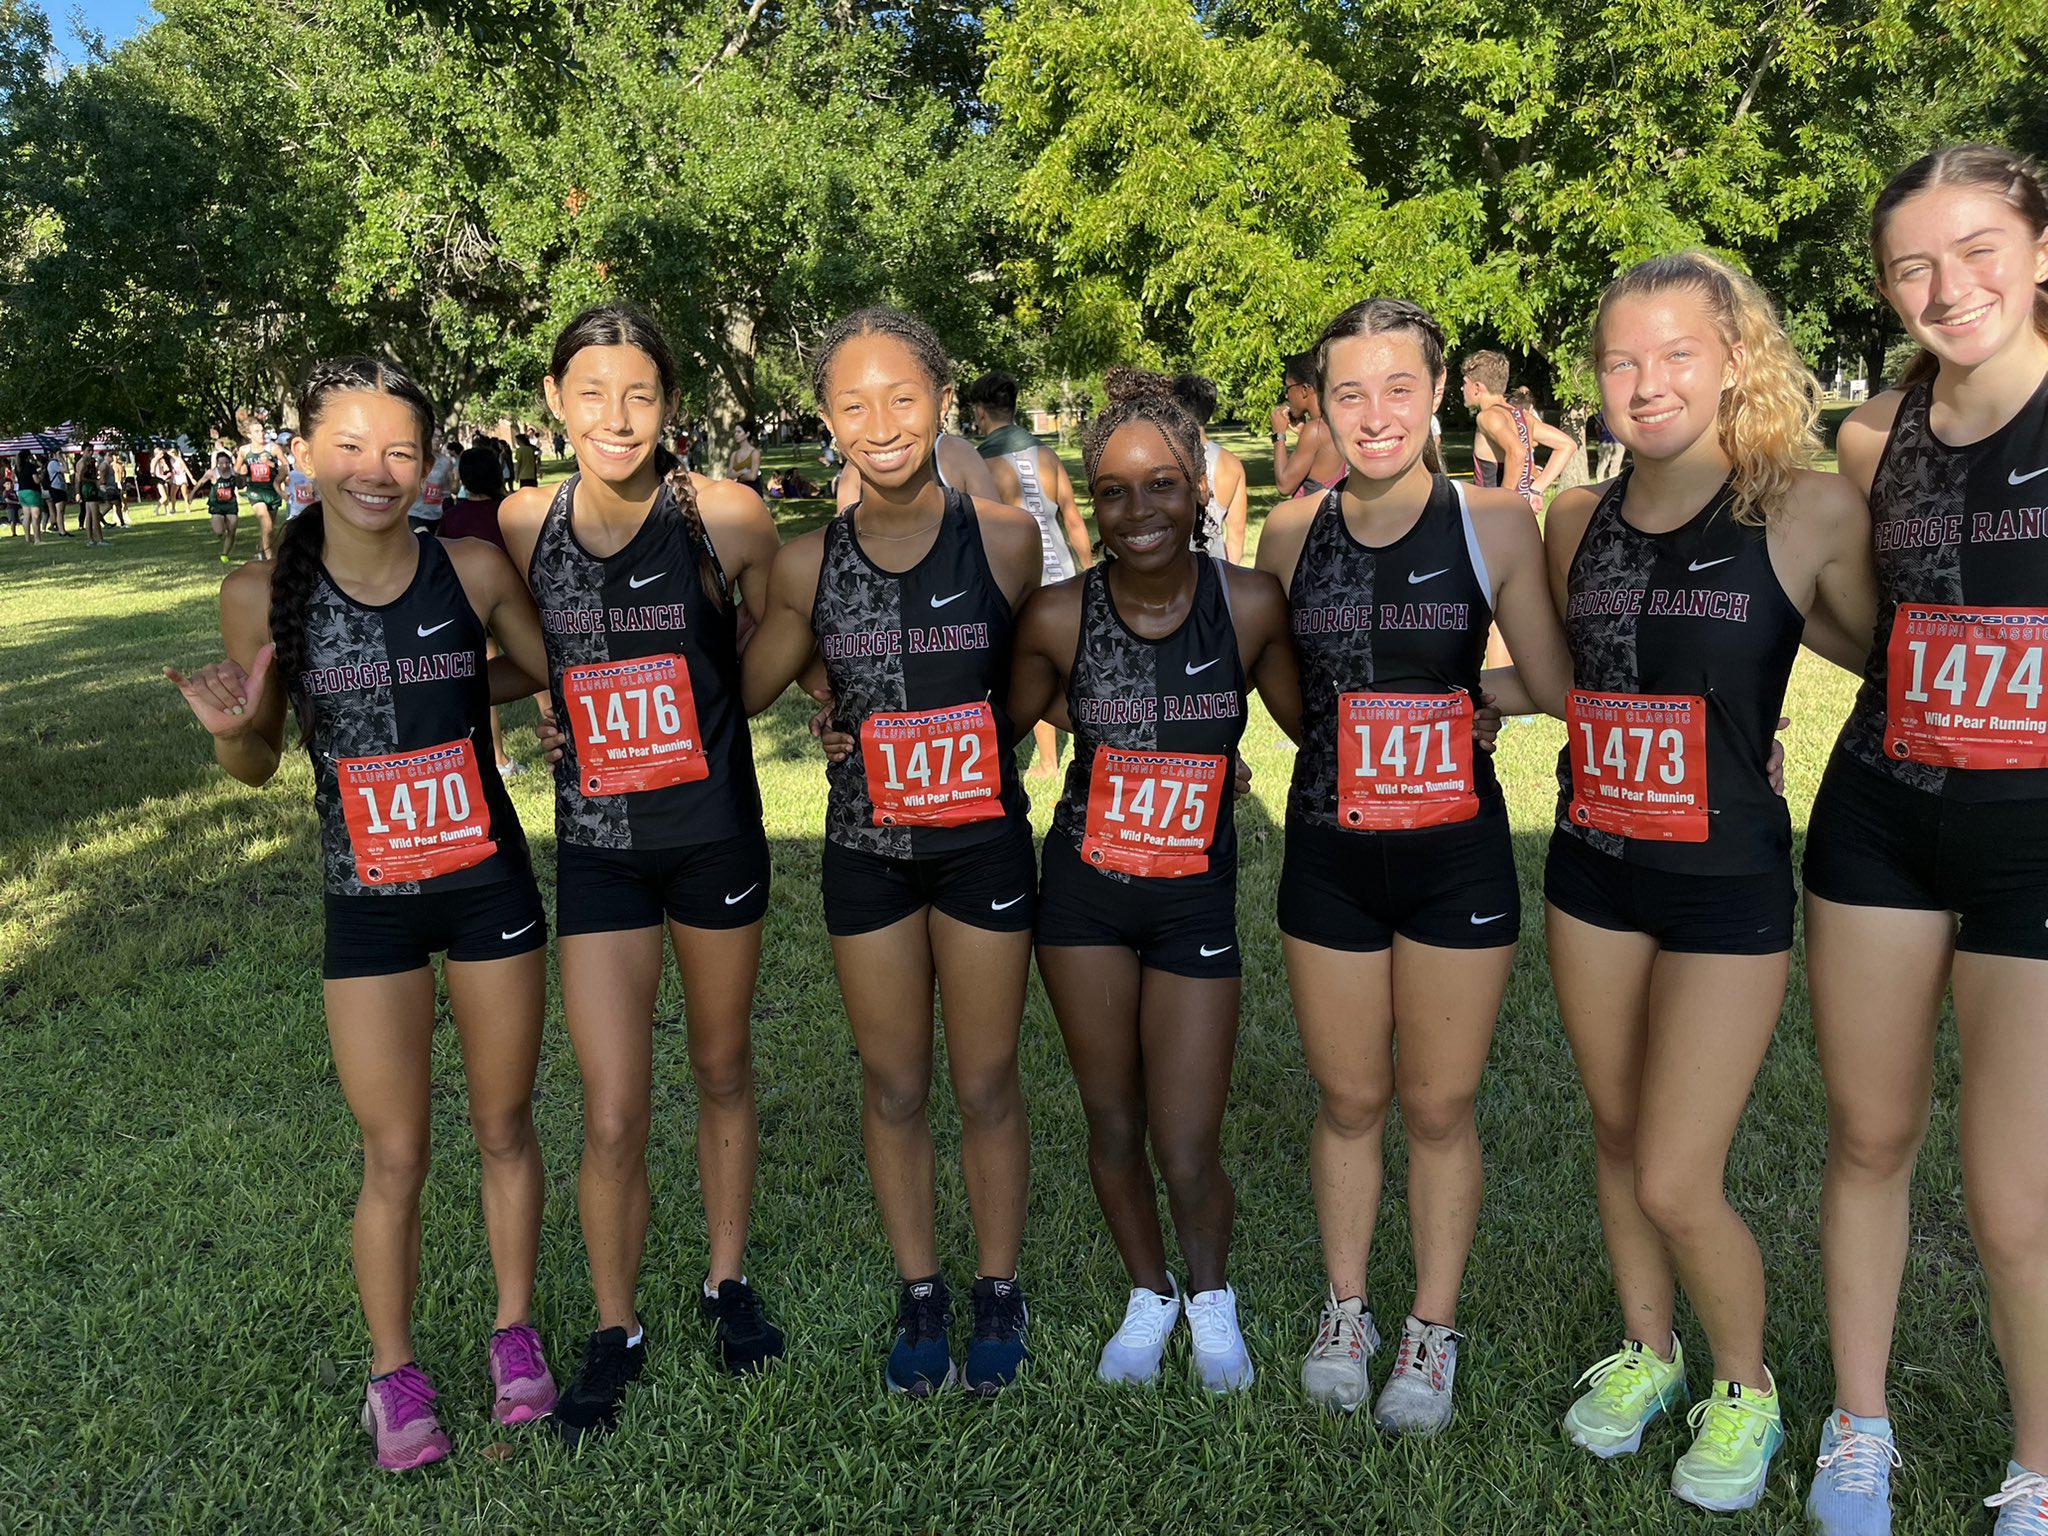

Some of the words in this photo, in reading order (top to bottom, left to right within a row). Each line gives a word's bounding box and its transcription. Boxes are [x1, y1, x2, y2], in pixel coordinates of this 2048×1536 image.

[1013, 453, 1065, 582] ONGHORN
[1875, 515, 1963, 552] GEORGE
[1970, 507, 2048, 543] RAN
[1648, 589, 1750, 623] RANCH
[1908, 611, 2048, 626] DAWSON
[543, 608, 606, 634] EORGE
[609, 604, 686, 632] RANCH
[1294, 605, 1373, 635] GEORGE
[1379, 603, 1469, 630] RANCH
[1905, 623, 1966, 638] ALUMNI
[823, 629, 903, 660] GEORGE
[908, 622, 990, 653] RANCH
[300, 661, 392, 696] GEORGE
[397, 651, 476, 684] RANCH
[571, 658, 674, 680] DAWSON
[573, 676, 615, 692] ALUMNI
[620, 669, 677, 687] CLASSIC
[1904, 641, 2043, 709] 1474
[579, 684, 681, 744] 1476
[1078, 696, 1158, 725] GEORGE
[1163, 690, 1240, 721] RANCH
[1349, 709, 1400, 721] ALUMNI
[1574, 695, 1690, 711] DAWSON
[1575, 706, 1618, 722] ALUMNI
[1626, 711, 1691, 724] CLASSIC
[872, 726, 921, 739] ALUMNI
[928, 718, 985, 736] CLASSIC
[874, 707, 982, 727] DAWSON
[1924, 711, 1950, 728] Wild
[1954, 714, 1986, 729] Pear
[1989, 716, 2047, 734] Running
[347, 746, 463, 773] DAWSON
[606, 747, 627, 760] Wild
[628, 747, 650, 758] Pear
[651, 739, 692, 755] Running
[879, 733, 983, 790] 1472
[1106, 752, 1217, 769] DAWSON
[1354, 721, 1457, 777] 1471
[1579, 722, 1685, 785] 1473
[350, 768, 400, 784] ALUMNI
[407, 756, 466, 778] CLASSIC
[1105, 763, 1153, 775] ALUMNI
[1159, 766, 1216, 779] CLASSIC
[902, 794, 925, 808] Wild
[927, 792, 950, 804] Pear
[951, 786, 992, 801] Running
[1375, 782, 1398, 795] Wild
[1400, 782, 1424, 794] Pear
[1425, 778, 1465, 793] Running
[1599, 784, 1620, 799] Wild
[1621, 788, 1645, 802] Pear
[1647, 790, 1695, 805] Running
[358, 772, 471, 834] 1470
[1104, 775, 1208, 831] 1475
[389, 835, 413, 850] Wild
[413, 834, 439, 848] Pear
[440, 825, 483, 842] Running
[1120, 828, 1141, 843] Wild
[1142, 833, 1166, 846] Pear
[1167, 834, 1205, 850] Running
